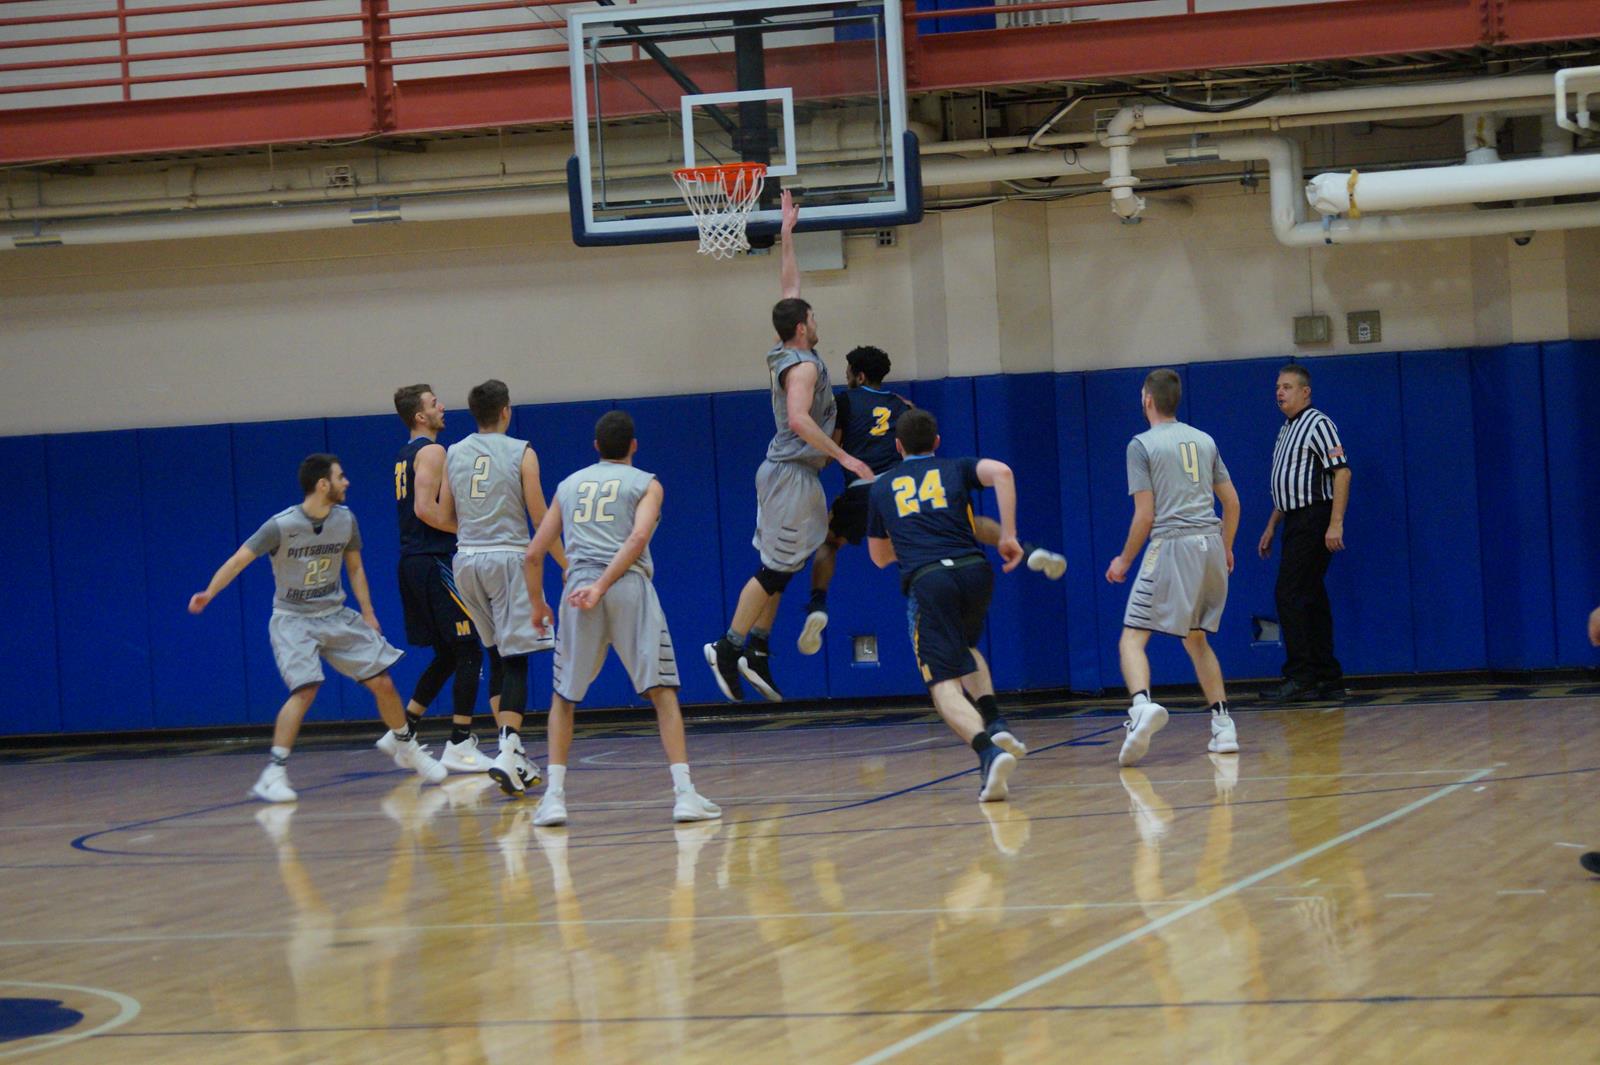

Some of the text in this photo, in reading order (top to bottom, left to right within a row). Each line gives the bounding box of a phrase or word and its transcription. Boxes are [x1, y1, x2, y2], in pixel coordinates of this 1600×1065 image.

[869, 406, 892, 436] 3
[470, 454, 491, 499] 2
[1179, 441, 1200, 483] 4
[572, 479, 621, 524] 32
[891, 468, 948, 518] 24
[303, 556, 332, 586] 22
[455, 620, 471, 636] M
